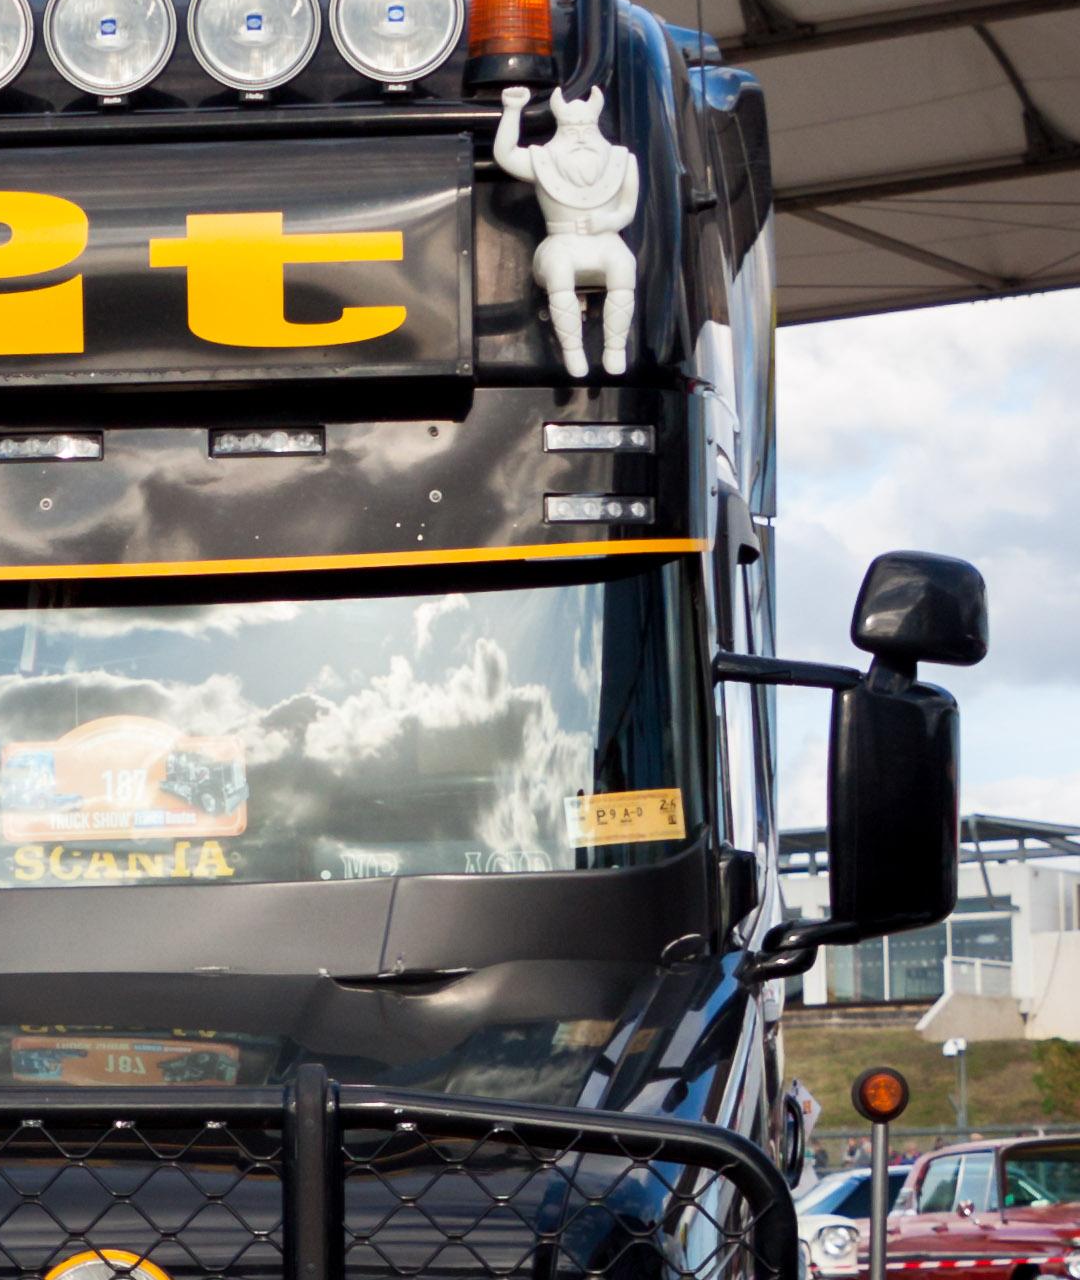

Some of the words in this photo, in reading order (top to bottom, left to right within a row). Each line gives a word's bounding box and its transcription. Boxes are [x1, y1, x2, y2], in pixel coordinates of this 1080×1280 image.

[101, 768, 148, 802] 187
[51, 813, 88, 829] TRUCK
[92, 811, 131, 827] SHOW
